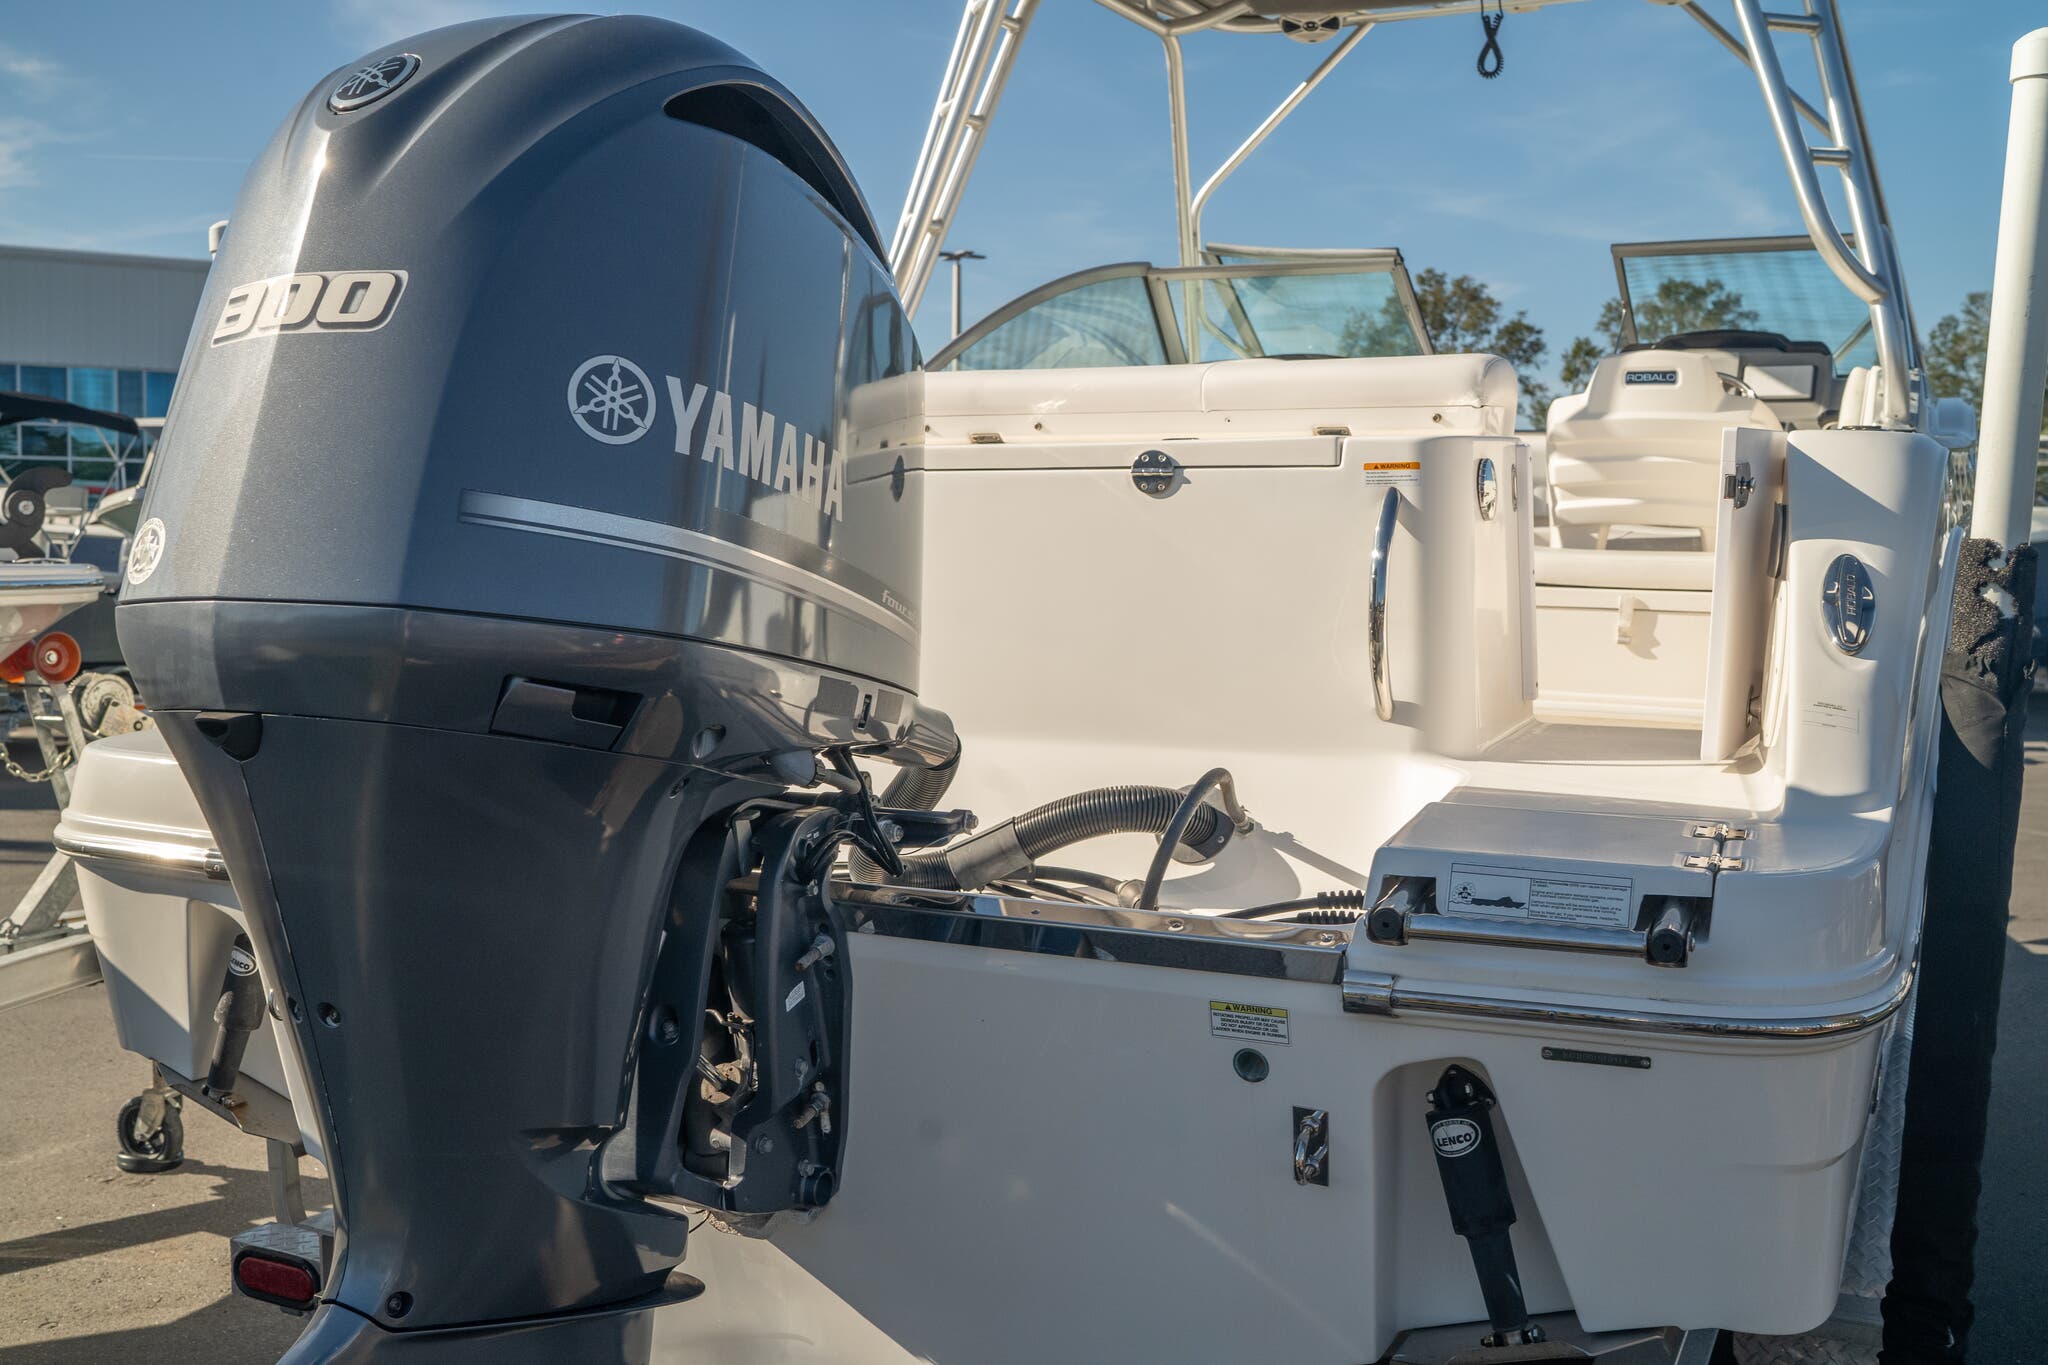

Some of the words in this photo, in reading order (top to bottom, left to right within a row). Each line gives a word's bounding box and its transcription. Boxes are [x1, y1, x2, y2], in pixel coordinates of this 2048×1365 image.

[212, 272, 402, 346] 300
[1626, 373, 1676, 382] ROBALO
[665, 374, 844, 523] YAMAHA
[1233, 1004, 1273, 1015] WARNING
[1437, 1133, 1472, 1147] LENCO
